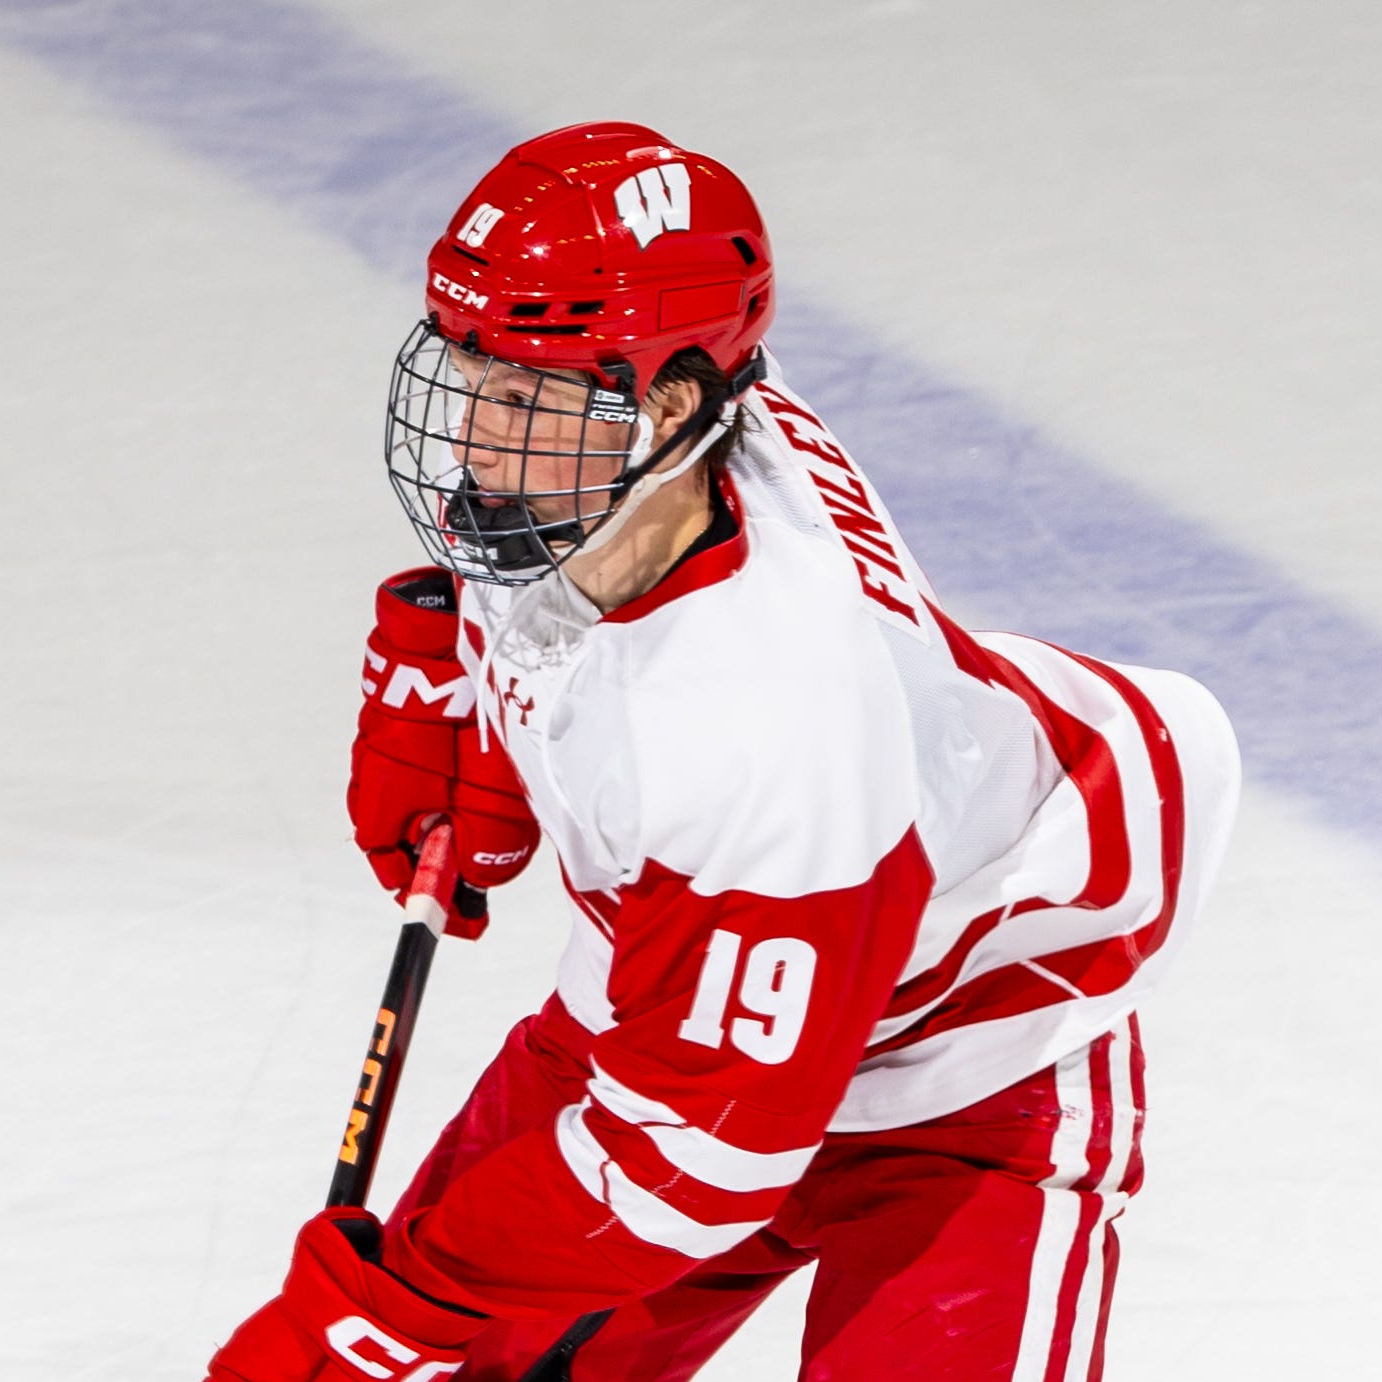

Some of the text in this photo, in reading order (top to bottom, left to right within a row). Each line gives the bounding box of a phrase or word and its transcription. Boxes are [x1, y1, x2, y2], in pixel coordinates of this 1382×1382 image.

[456, 202, 505, 248] 19
[613, 162, 692, 251] W
[433, 271, 489, 310] CCM
[589, 410, 637, 424] CCM
[753, 381, 921, 628] FINLEY
[416, 595, 446, 608] CCM
[472, 845, 530, 866] CCM
[677, 928, 818, 1066] 19
[338, 1008, 397, 1166] CCM
